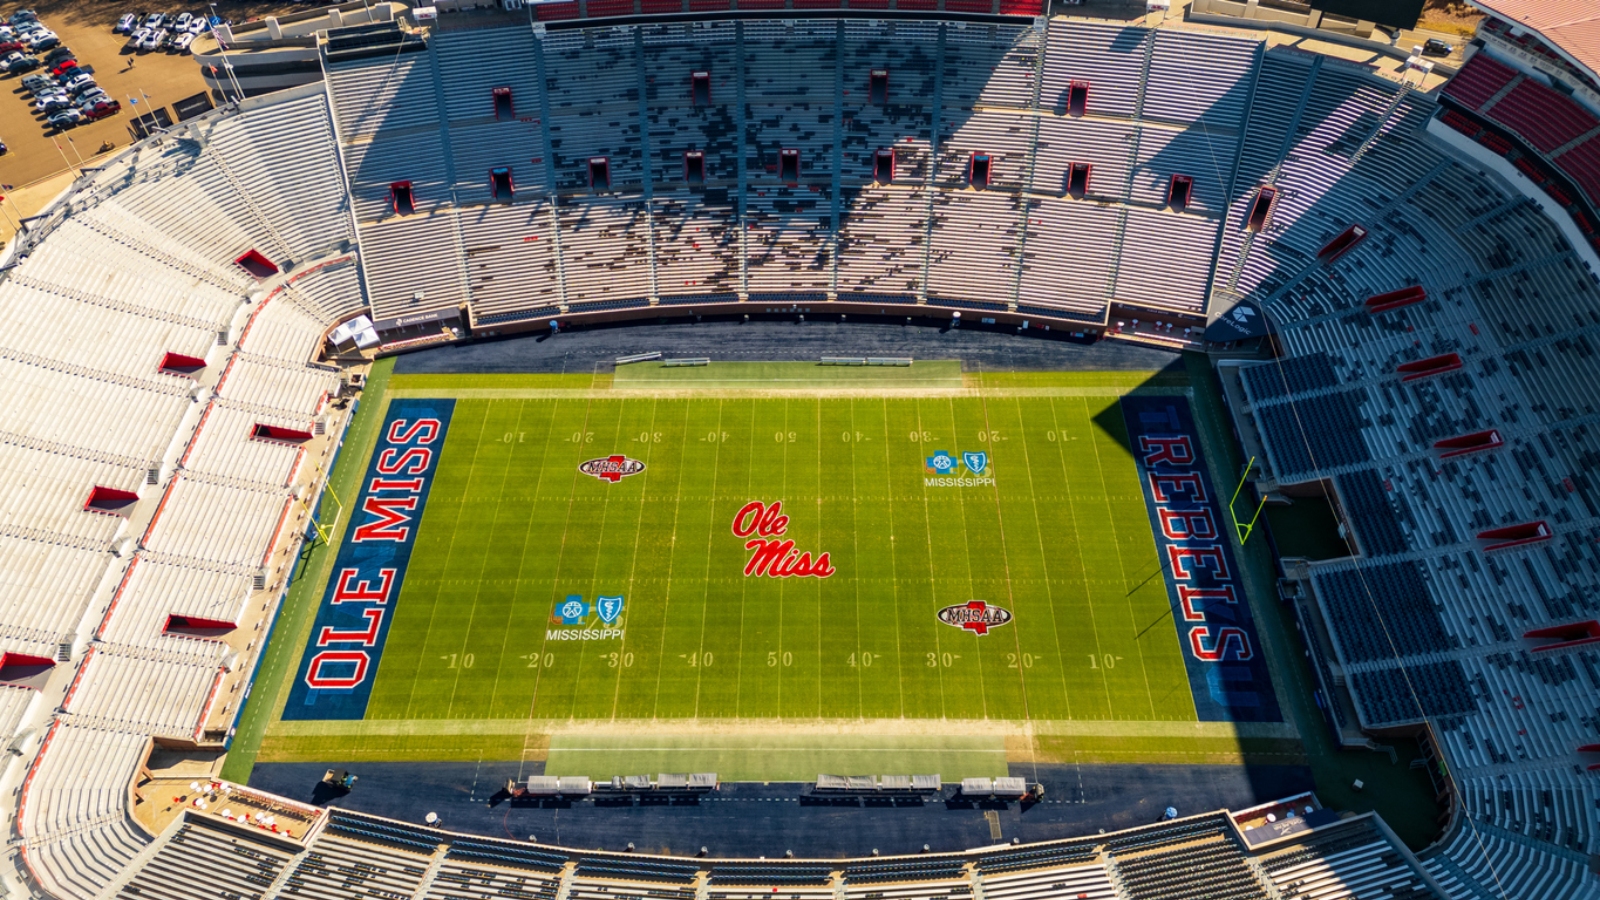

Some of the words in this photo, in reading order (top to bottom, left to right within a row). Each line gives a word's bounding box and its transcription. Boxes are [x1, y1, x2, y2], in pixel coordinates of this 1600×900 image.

[1214, 311, 1252, 335] CoreLogic
[586, 460, 638, 473] MHSAA
[925, 477, 996, 488] MISSISSIPPI
[731, 500, 790, 538] Ole
[304, 568, 397, 688] OLE
[351, 418, 442, 543] MISS
[1138, 435, 1254, 662] REBELS
[743, 538, 836, 578] Miss
[946, 607, 1004, 623] MHSAA
[546, 629, 625, 641] MISSISSIPPI
[447, 653, 475, 669] 10
[527, 652, 555, 668] 20
[607, 652, 635, 668] 30
[687, 652, 714, 668] 40
[767, 651, 793, 668] 50
[846, 652, 872, 668] 40
[926, 652, 953, 668] 30
[1006, 653, 1034, 669] 20
[1087, 653, 1115, 669] 10
